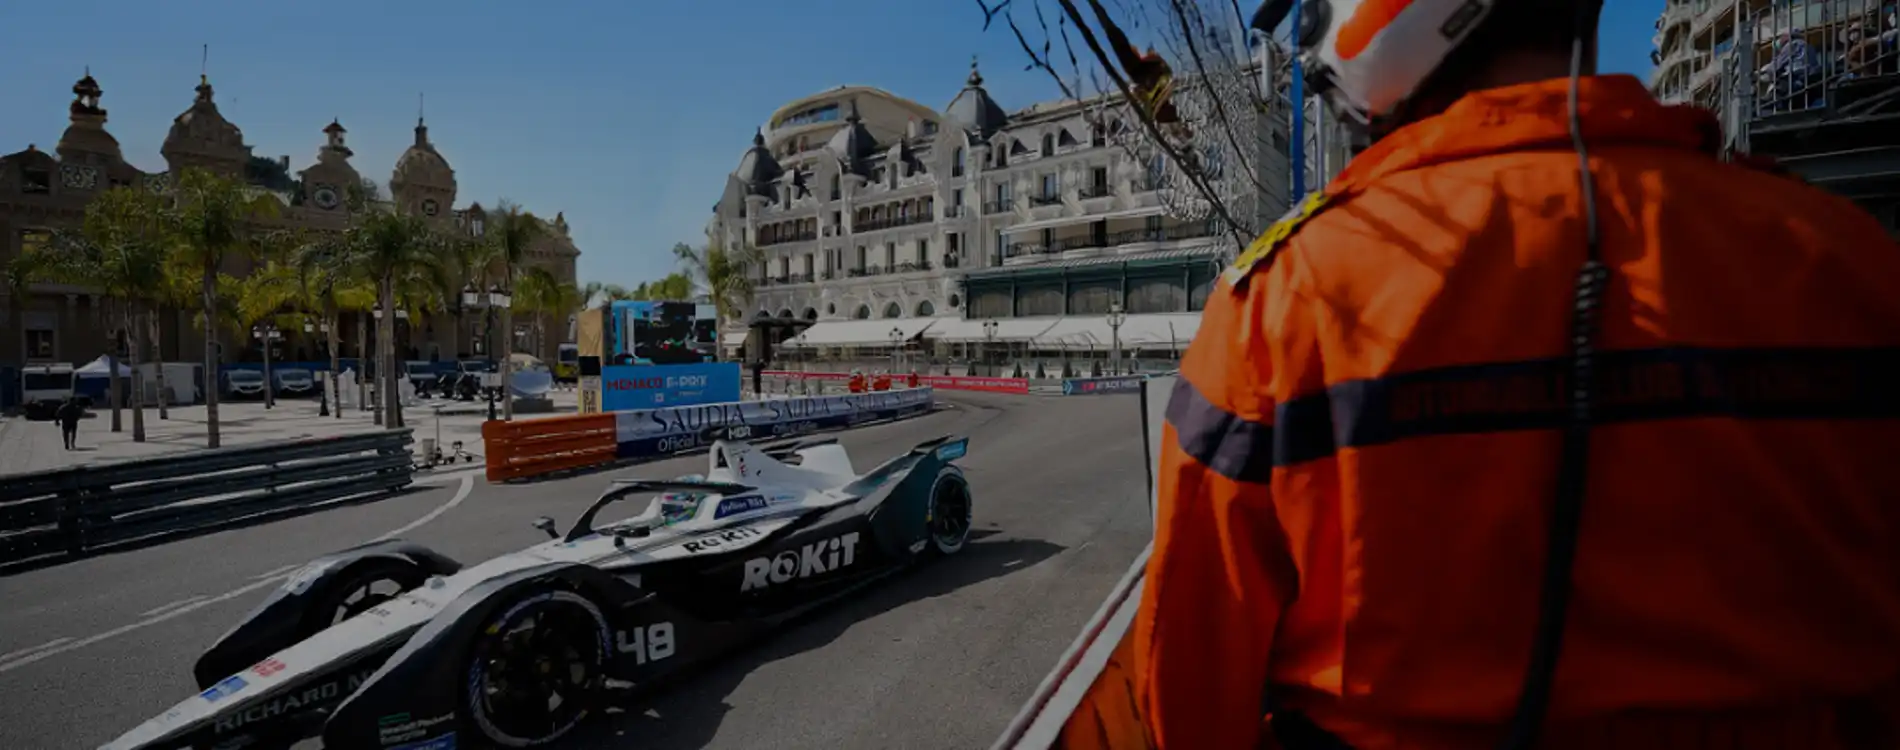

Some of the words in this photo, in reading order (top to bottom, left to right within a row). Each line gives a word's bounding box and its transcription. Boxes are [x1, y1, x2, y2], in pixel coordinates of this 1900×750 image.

[652, 403, 745, 433] SAUDIA
[768, 398, 830, 420] SAUDA
[616, 621, 676, 667] 48
[214, 680, 338, 735] RICHARD
